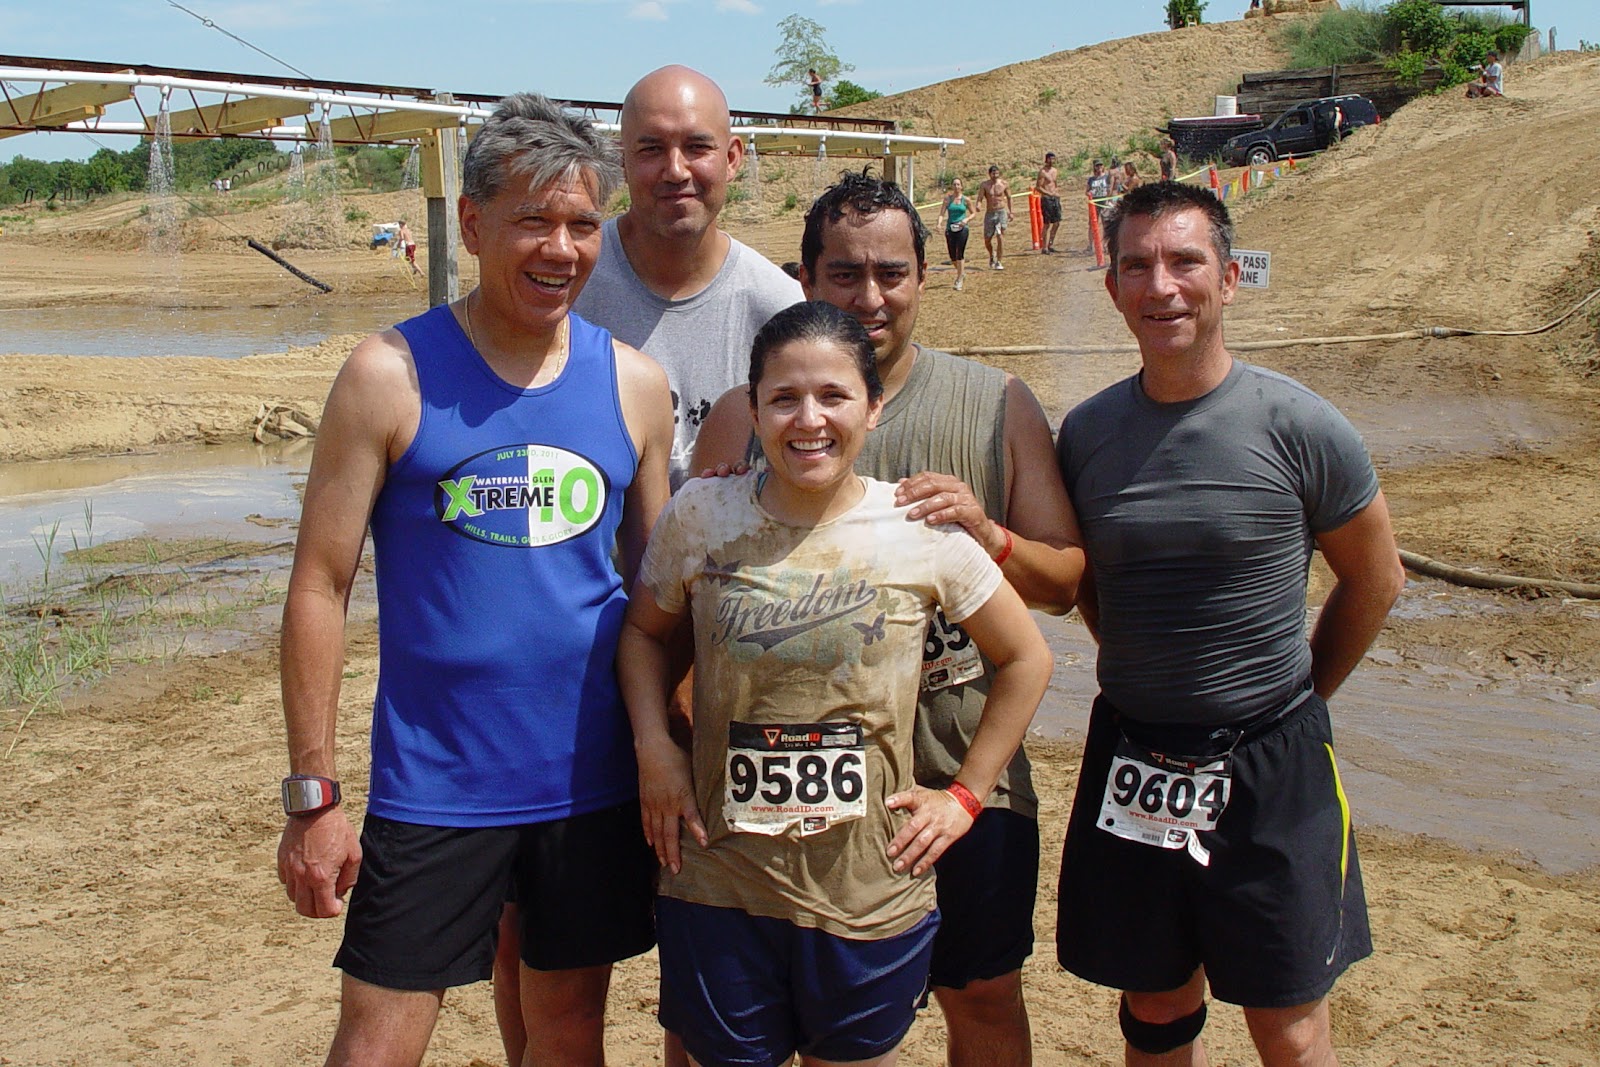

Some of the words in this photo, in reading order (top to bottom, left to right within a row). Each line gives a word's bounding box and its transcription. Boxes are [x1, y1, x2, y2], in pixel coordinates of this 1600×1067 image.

[1243, 255, 1267, 269] PASS
[1239, 270, 1259, 283] ANE
[496, 450, 514, 461] JULY
[476, 476, 529, 486] WATERFALL
[532, 476, 555, 484] GLEN
[438, 475, 555, 522] XTREME
[532, 467, 599, 525] 10
[464, 523, 487, 539] HILLS,
[490, 532, 520, 544] TRAILS,
[711, 573, 877, 646] Freedom
[729, 753, 864, 805] 9586
[1112, 763, 1225, 822] 9604
[751, 805, 835, 813] www.RoadID.com
[1128, 810, 1198, 828] www.RoadID.com
